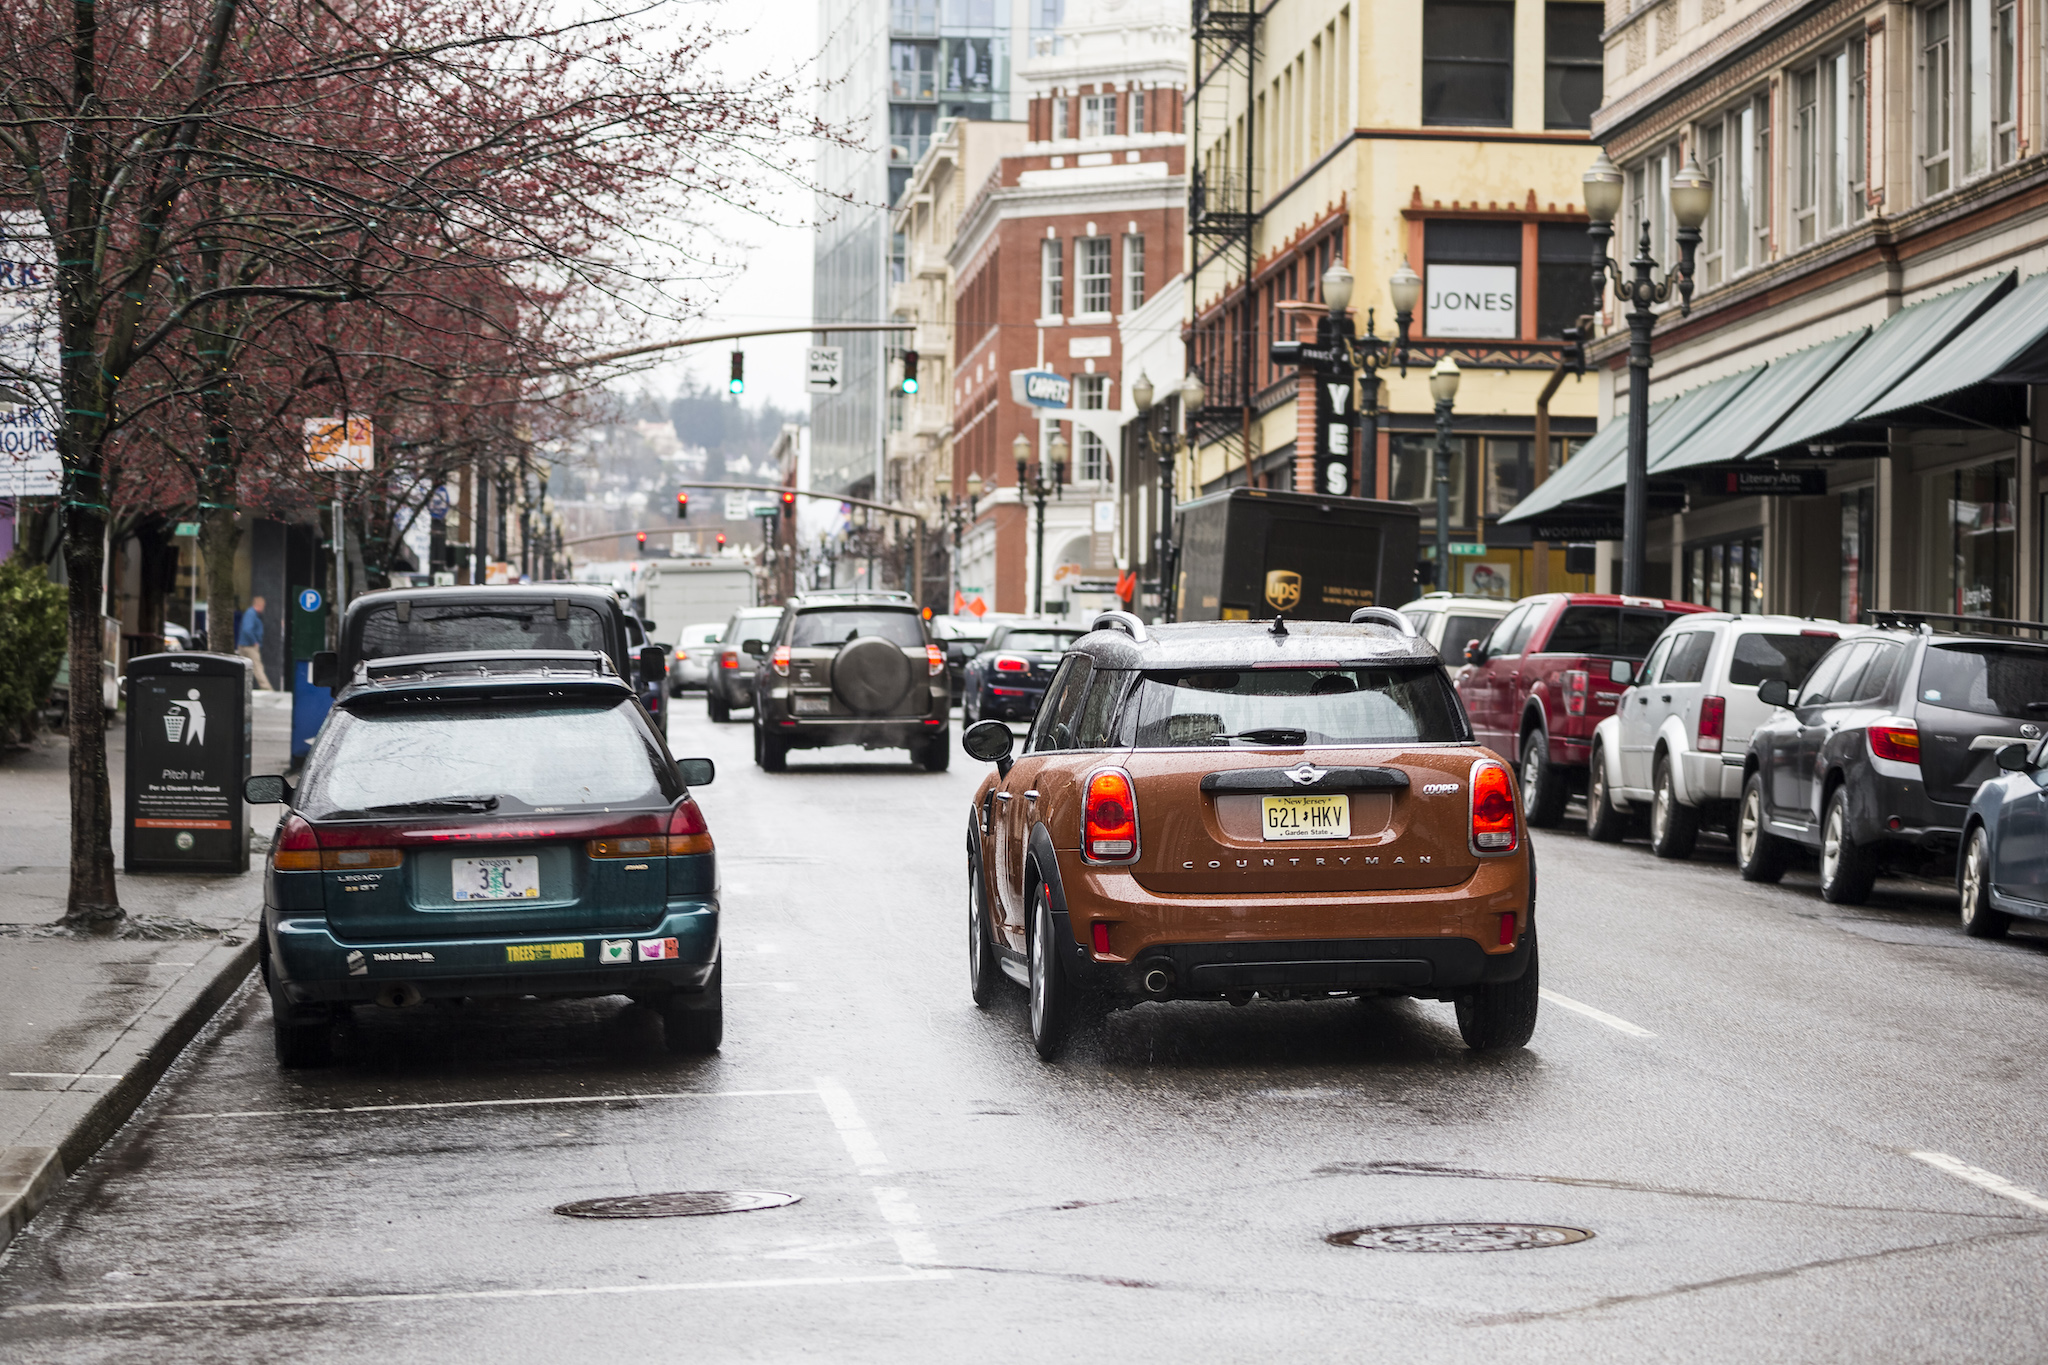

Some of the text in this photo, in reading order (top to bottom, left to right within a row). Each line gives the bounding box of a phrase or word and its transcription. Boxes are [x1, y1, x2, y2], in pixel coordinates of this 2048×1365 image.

[1430, 292, 1513, 311] JONES
[811, 351, 838, 361] ONE
[811, 364, 838, 372] WAY
[1740, 472, 1801, 485] Literary Arts
[306, 590, 317, 608] P
[1268, 582, 1299, 604] ups
[162, 769, 205, 780] Pitch In!
[1423, 784, 1459, 795] COOPER
[1284, 797, 1326, 806] New Jersey
[1268, 806, 1342, 828] G21 HKV
[431, 828, 557, 841] SUBARU
[478, 858, 512, 867] Oregon
[1182, 855, 1432, 869] COUNTRYMAN
[337, 873, 383, 884] LEGACY
[505, 944, 536, 963] TREES
[549, 941, 586, 961] ANSWER
